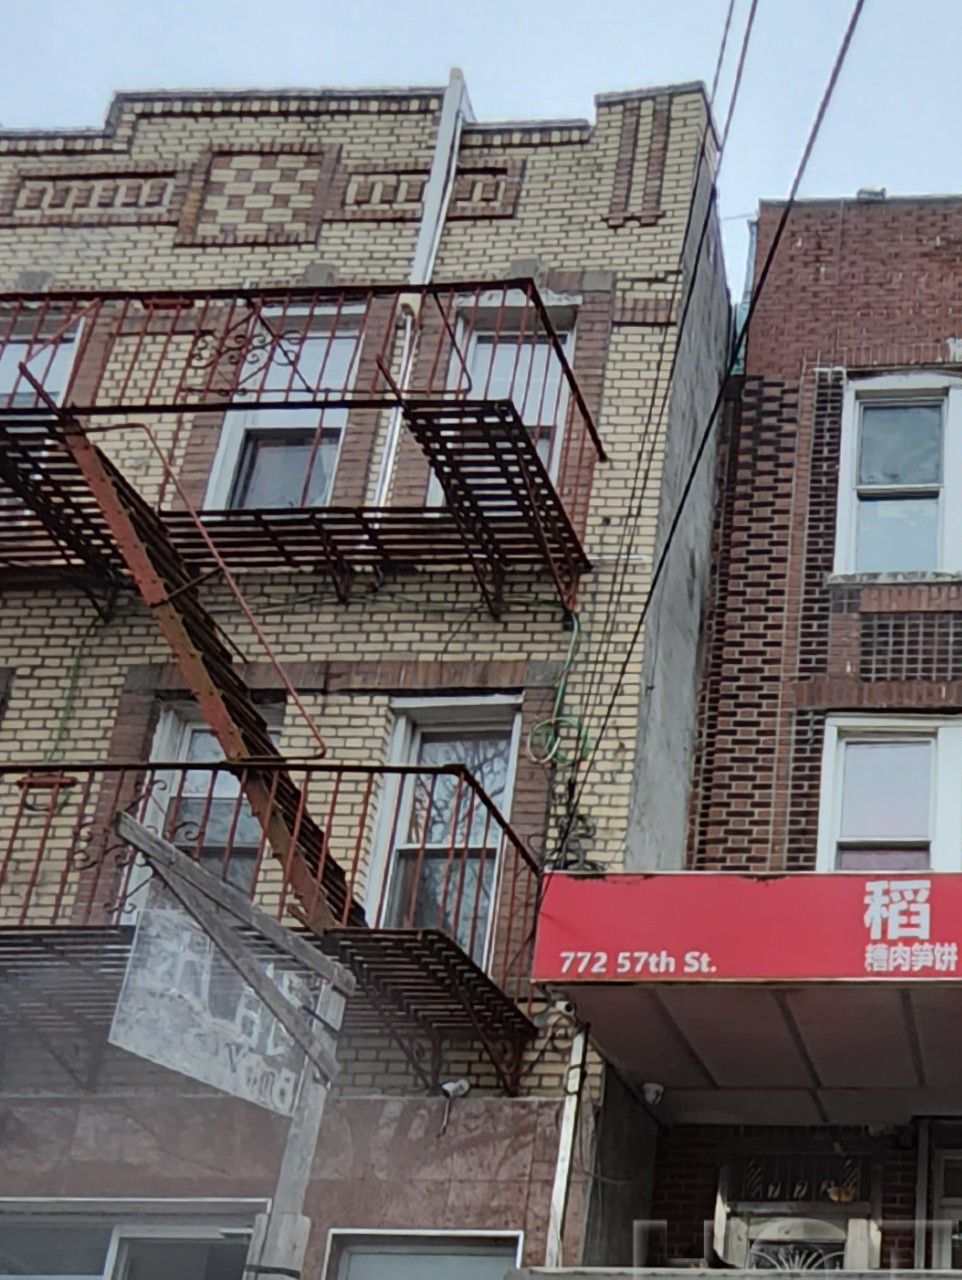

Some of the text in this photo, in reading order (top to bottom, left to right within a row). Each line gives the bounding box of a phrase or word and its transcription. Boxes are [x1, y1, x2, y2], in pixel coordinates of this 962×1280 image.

[559, 950, 717, 973] 772 57th St.
